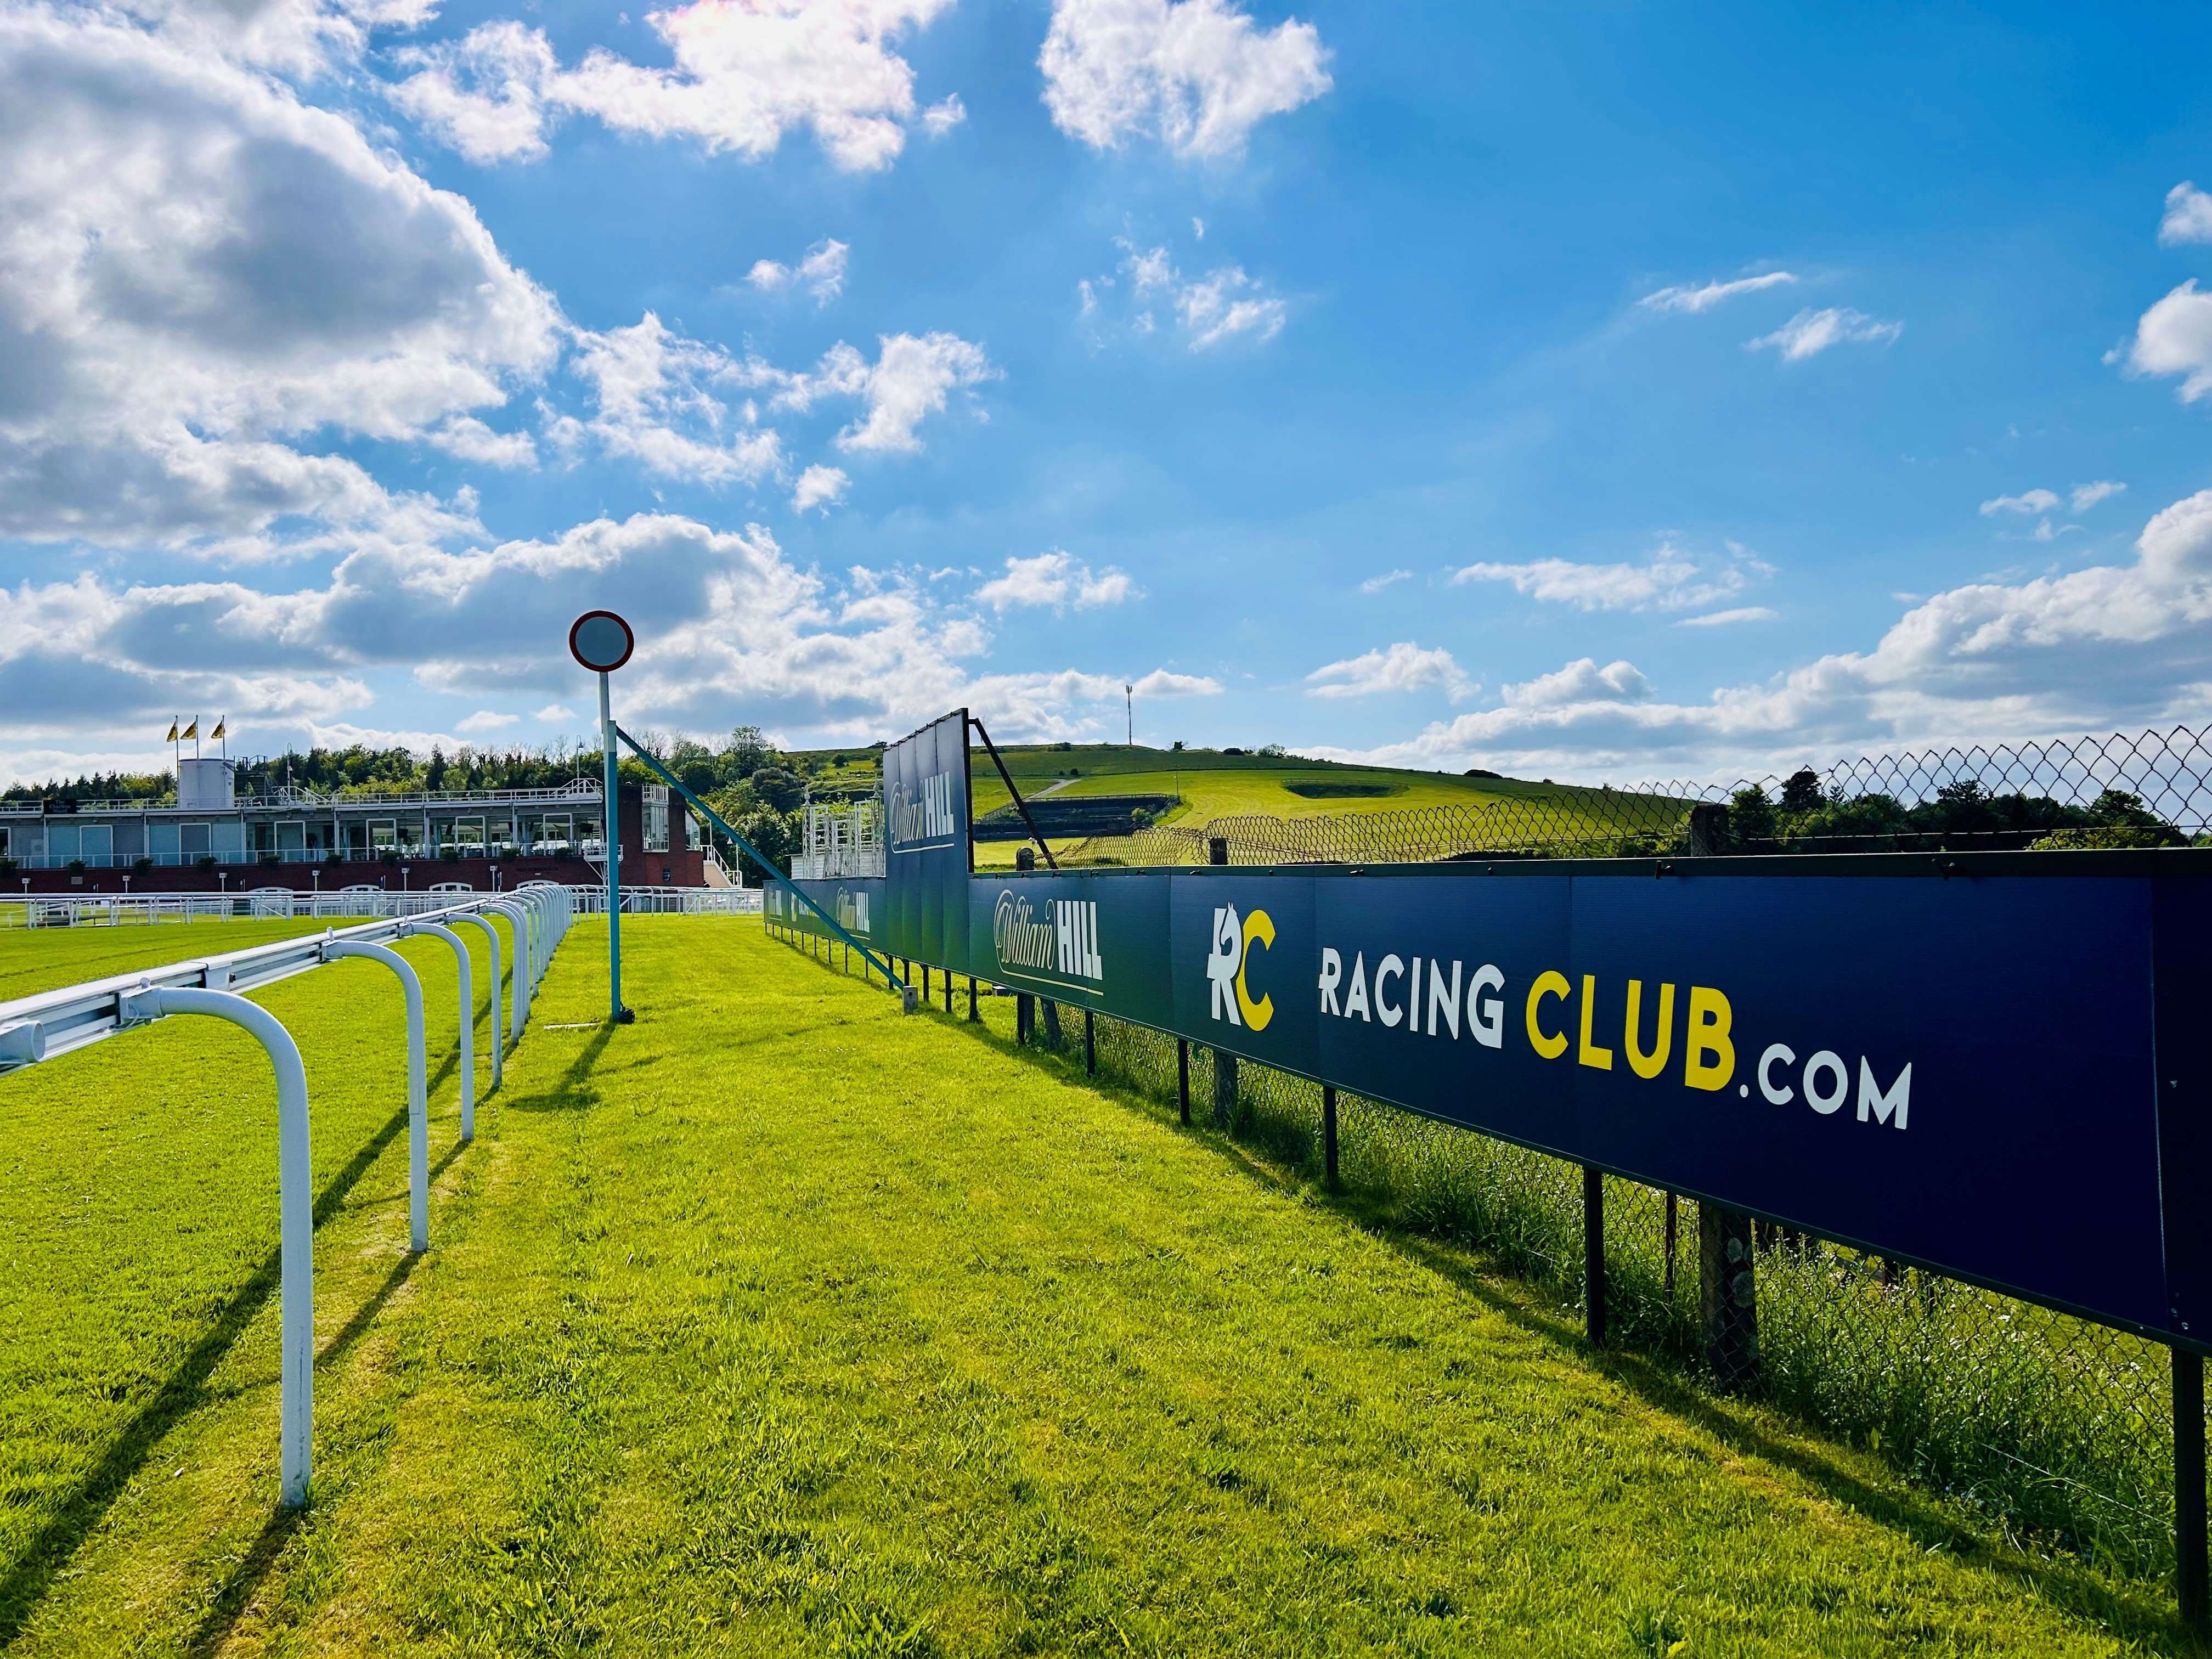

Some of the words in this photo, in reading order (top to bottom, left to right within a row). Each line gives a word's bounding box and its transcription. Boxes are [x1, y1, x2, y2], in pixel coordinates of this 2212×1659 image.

[889, 781, 924, 845] William
[924, 771, 954, 838] HILL
[856, 891, 870, 933] HILL
[994, 889, 1056, 970] William
[1057, 900, 1103, 981] HILL
[1207, 901, 1276, 1031] RC
